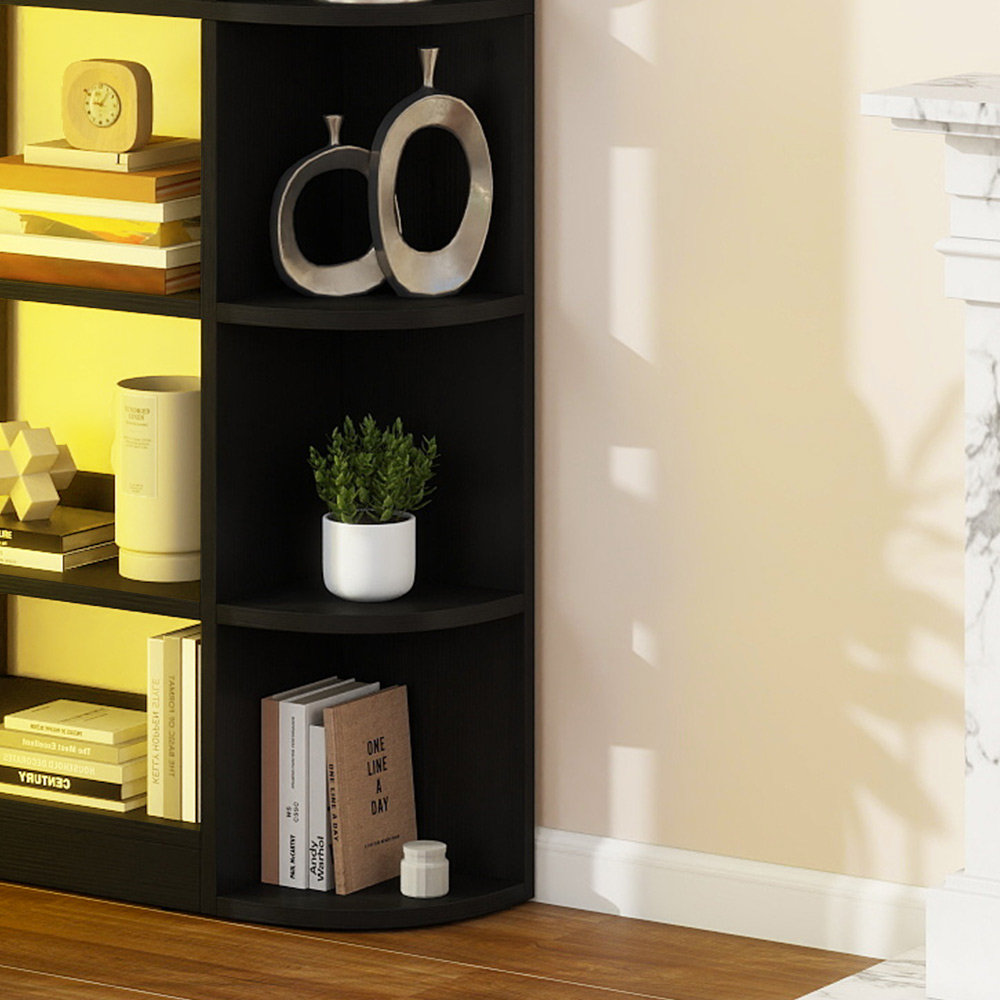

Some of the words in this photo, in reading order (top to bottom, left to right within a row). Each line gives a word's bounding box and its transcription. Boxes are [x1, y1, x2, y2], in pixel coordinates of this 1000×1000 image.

[366, 736, 385, 756] ONE
[367, 756, 388, 776] LINE
[376, 779, 382, 794] A
[370, 796, 389, 816] DAY
[309, 840, 319, 876] Andy
[317, 836, 325, 882] Warhol
